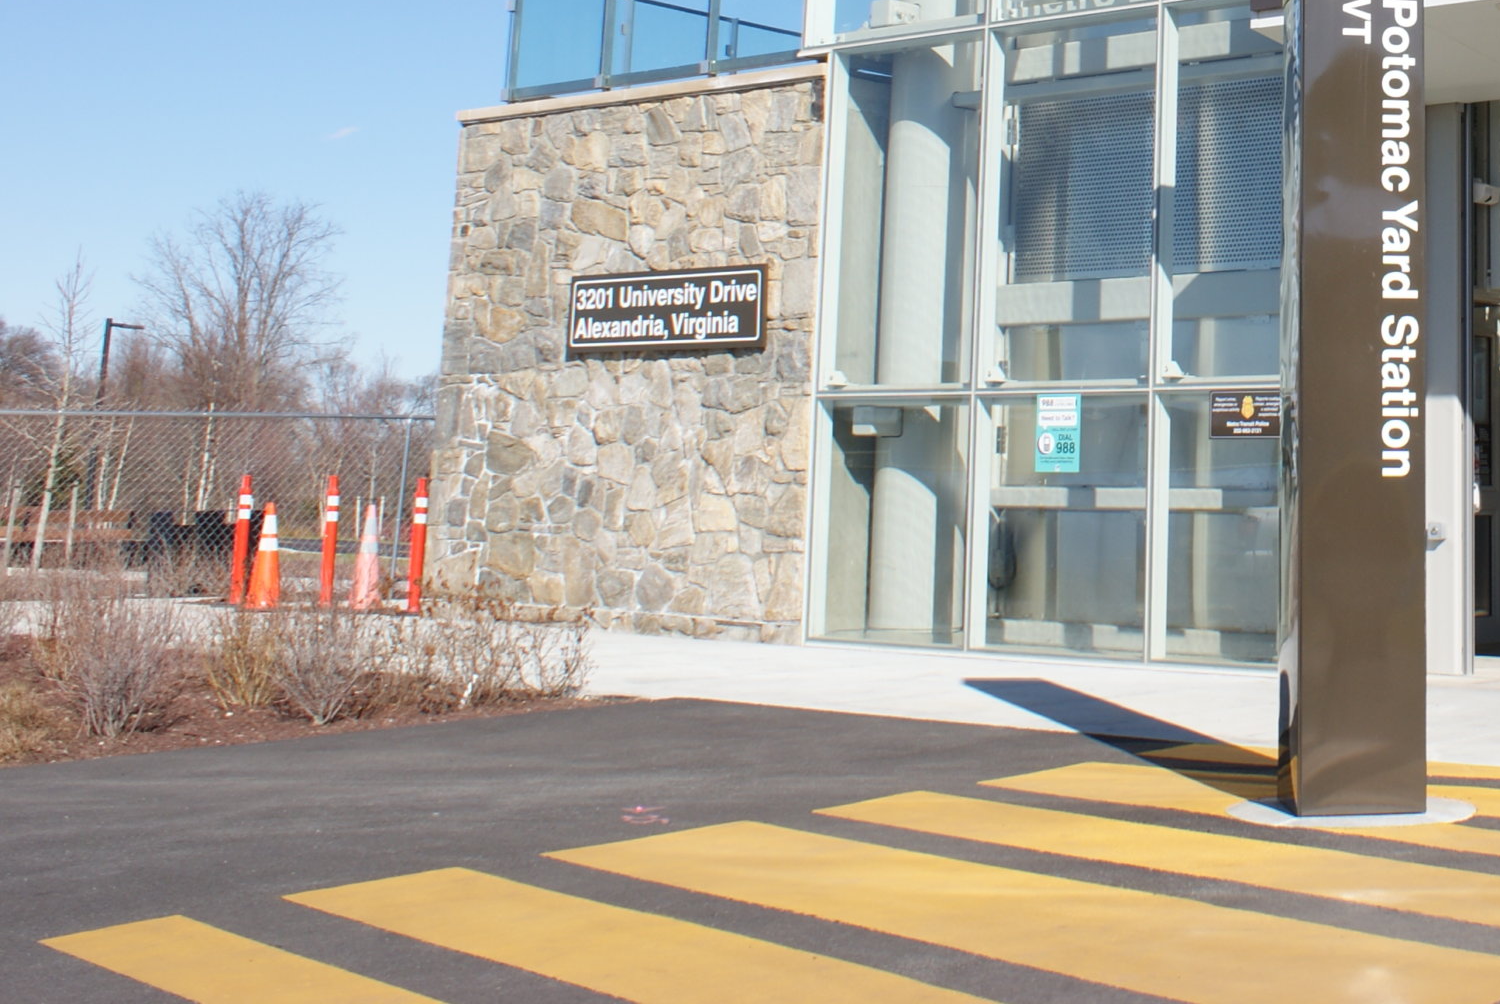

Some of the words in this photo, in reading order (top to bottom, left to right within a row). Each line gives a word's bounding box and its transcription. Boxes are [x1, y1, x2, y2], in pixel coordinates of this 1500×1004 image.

[1381, 200, 1419, 299] Yard
[576, 287, 613, 310] 3201
[619, 282, 706, 310] University
[709, 278, 757, 303] Drive
[573, 314, 669, 340] Alexandria,
[671, 310, 739, 340] Virginia
[1381, 313, 1419, 478] Station
[1055, 442, 1075, 454] 988
